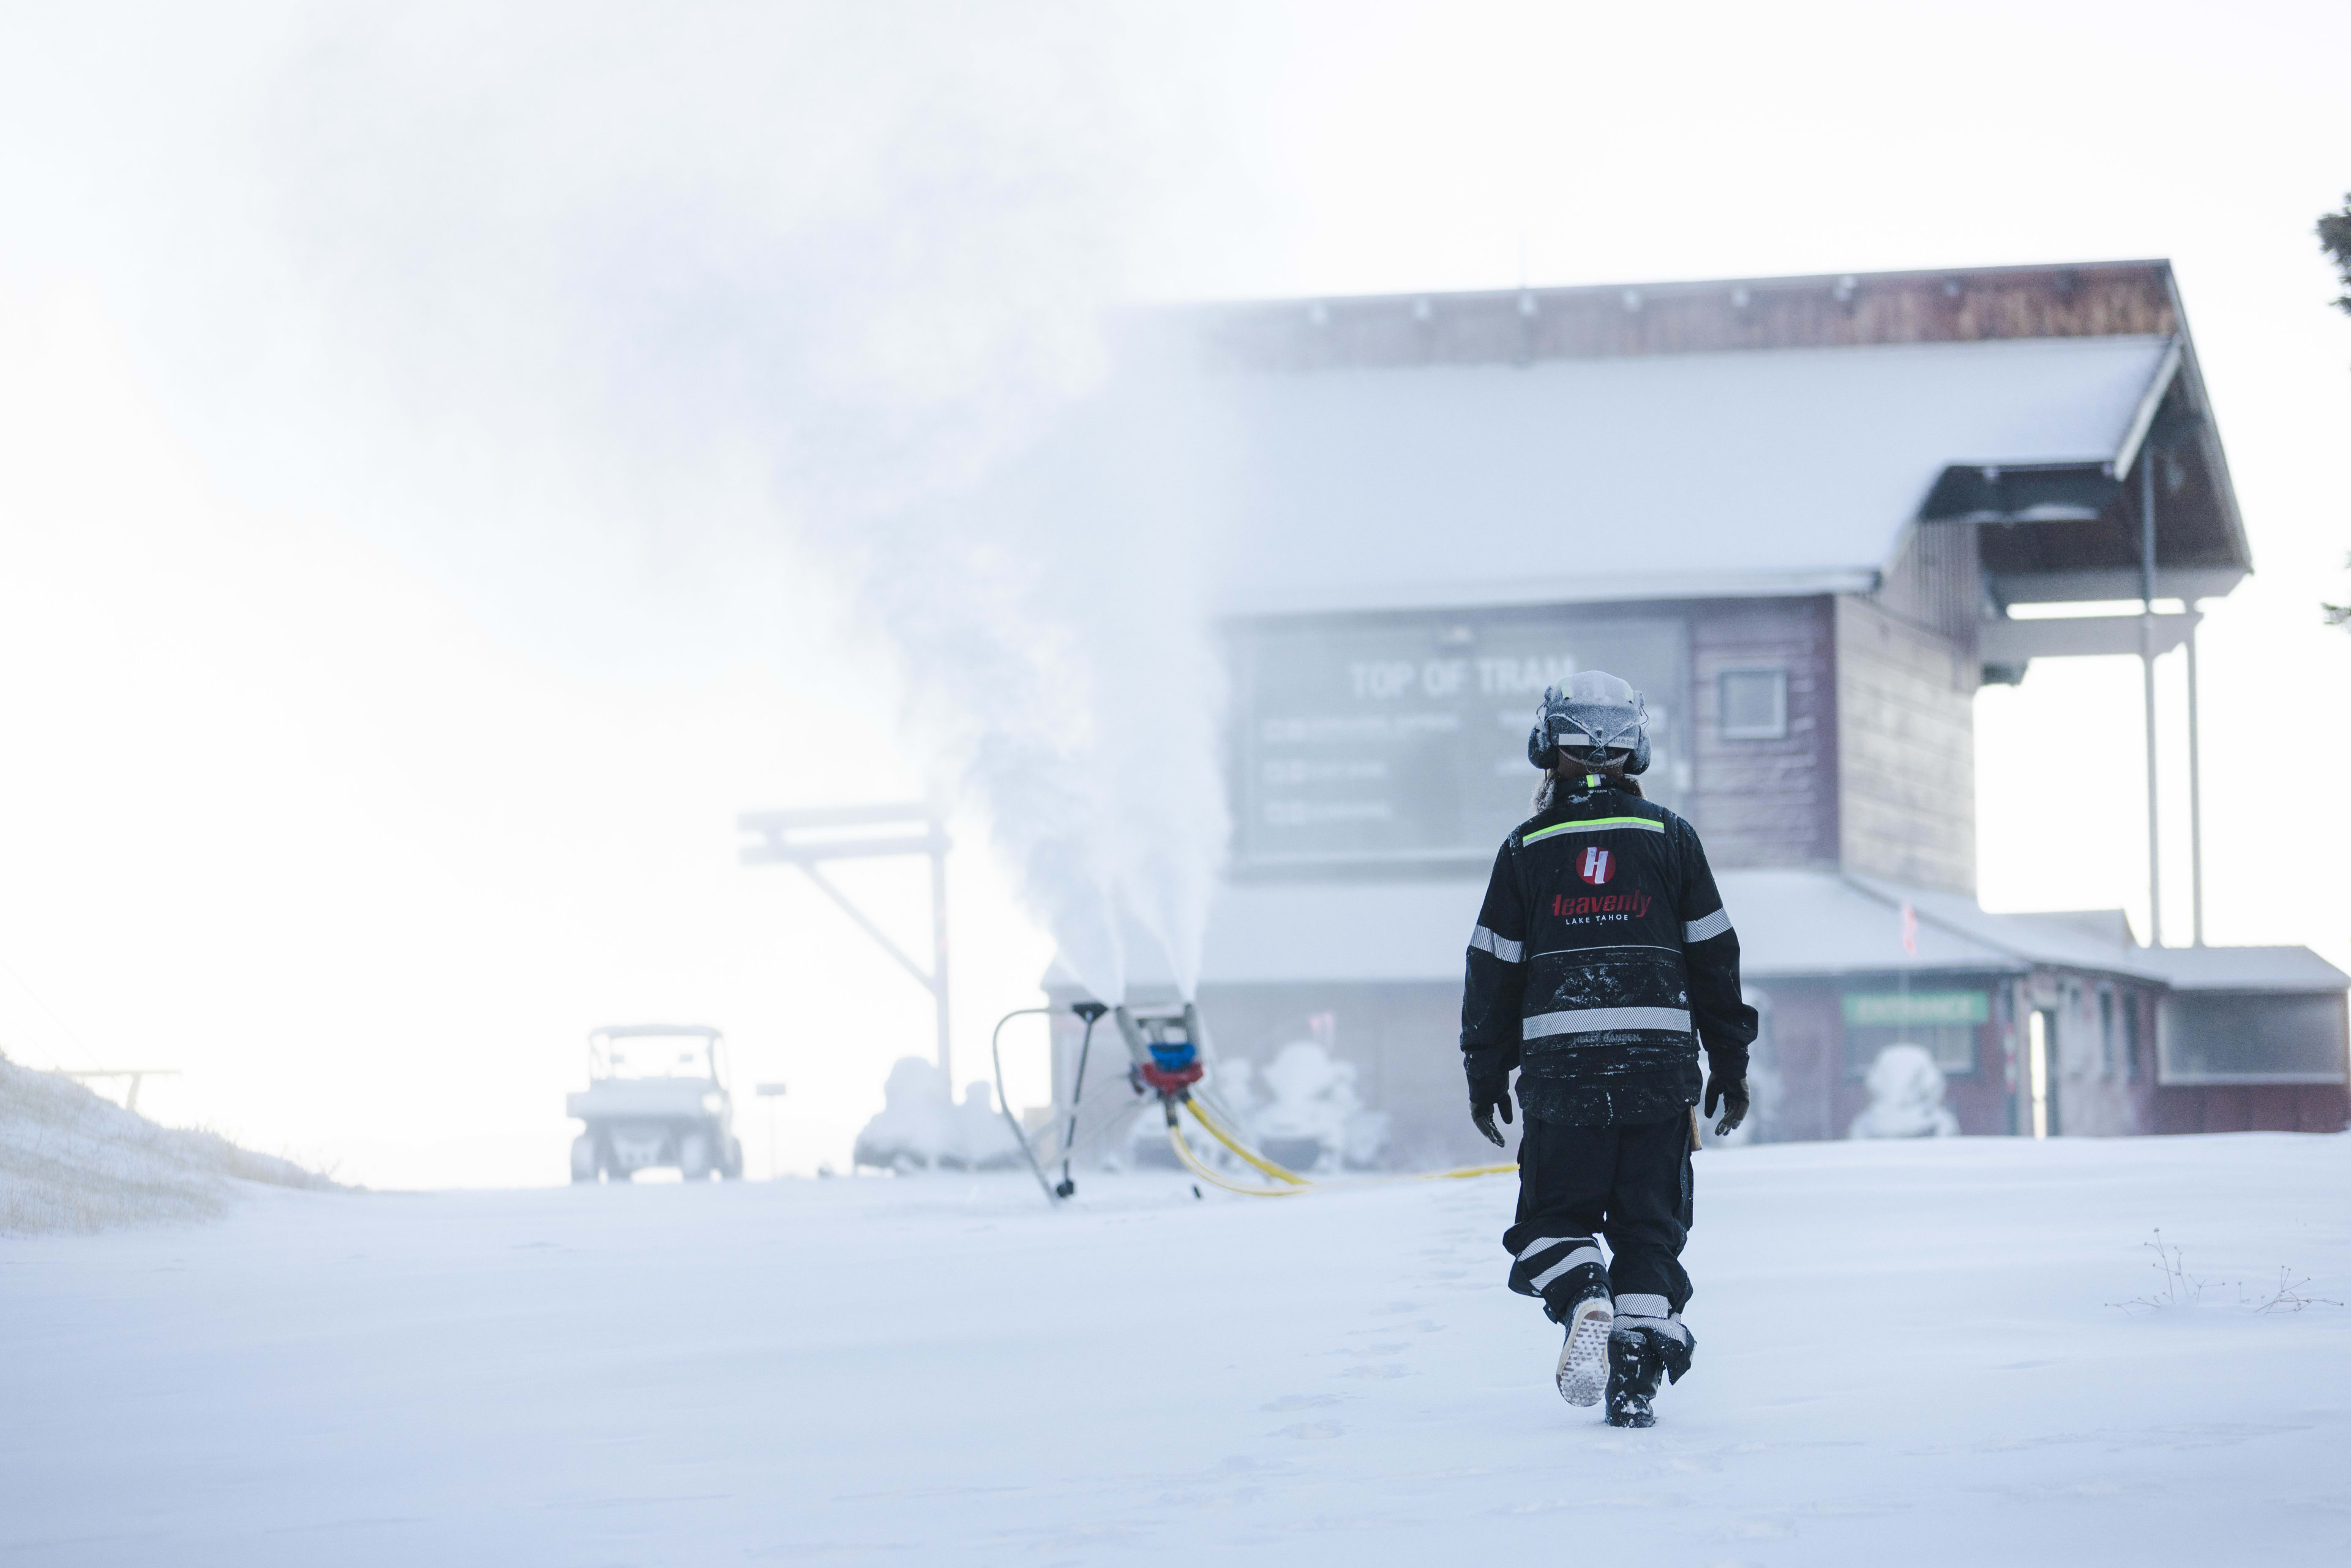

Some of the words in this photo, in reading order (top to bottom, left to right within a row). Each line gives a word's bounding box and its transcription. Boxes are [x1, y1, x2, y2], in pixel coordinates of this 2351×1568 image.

[1352, 661, 1414, 699] TOP
[1424, 659, 1465, 696] OF
[1475, 655, 1575, 695] TRAM
[1583, 847, 1609, 884] H
[1552, 890, 1651, 917] Heavenly
